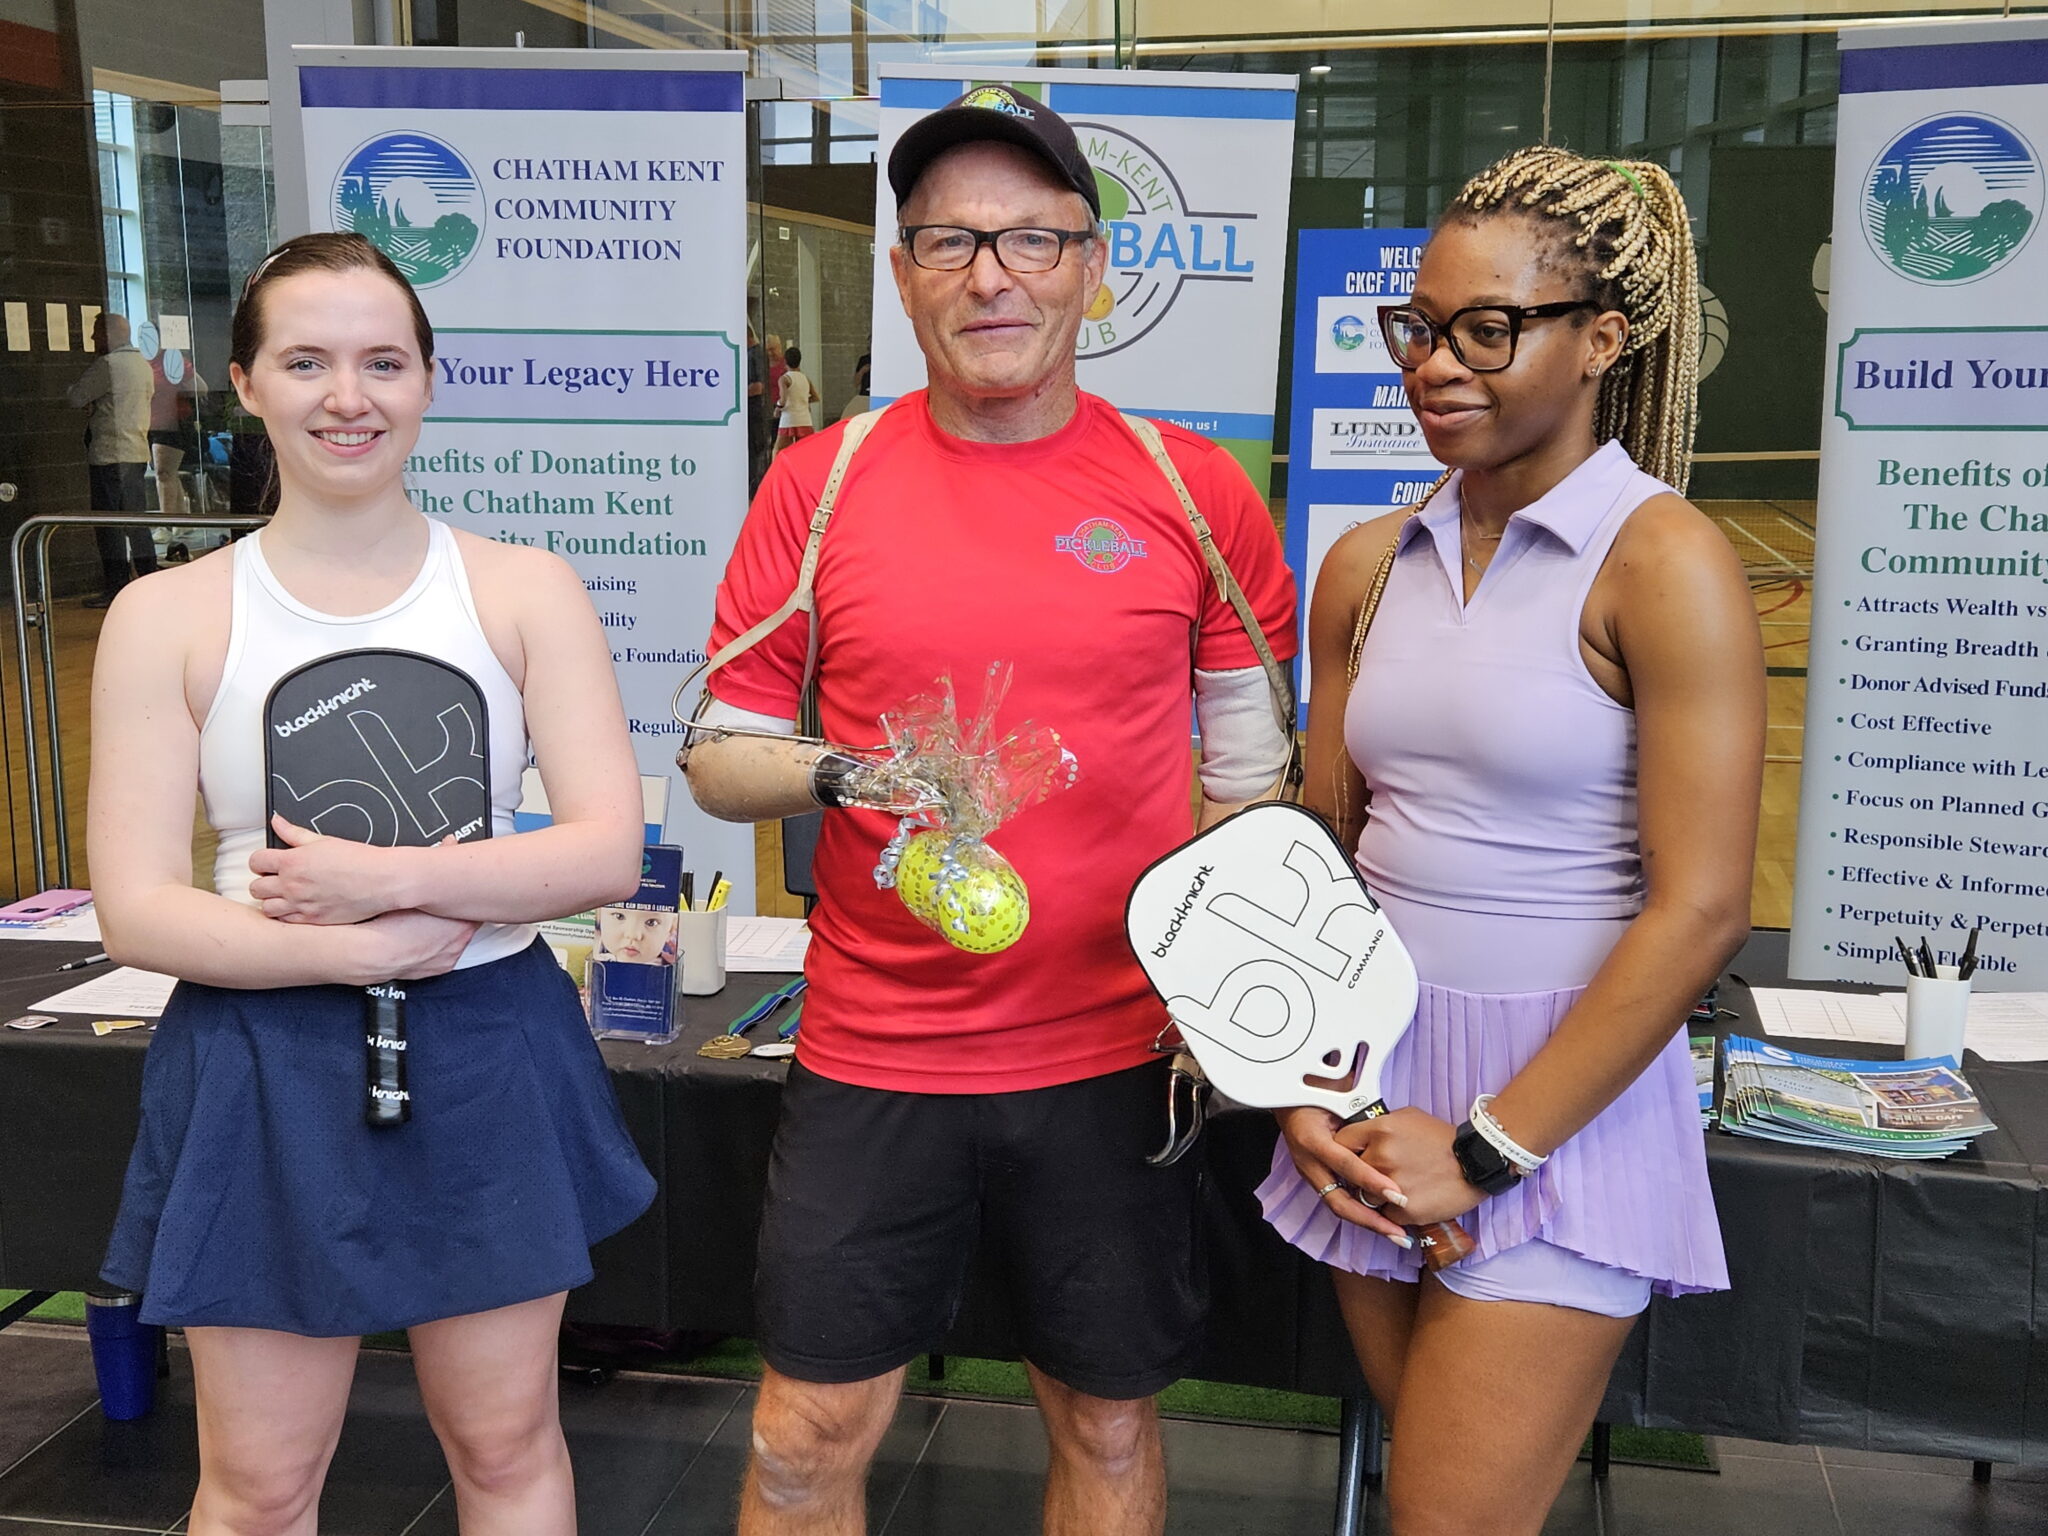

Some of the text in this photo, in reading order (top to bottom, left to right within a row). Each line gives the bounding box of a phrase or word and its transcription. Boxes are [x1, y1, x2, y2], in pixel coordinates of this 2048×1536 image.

[493, 158, 726, 183] CHATHAM KENT
[494, 198, 677, 221] COMMUNITY
[496, 237, 682, 261] FOUNDATION
[1099, 220, 1254, 273] BALL
[1345, 271, 1385, 294] CKCF
[438, 357, 721, 394] Your Legacy Here
[1854, 359, 1953, 390] Build
[1197, 421, 1210, 431] us
[1330, 421, 1424, 437] LUND
[1346, 434, 1420, 449] Insurance
[494, 449, 523, 475] of
[530, 449, 662, 482] Donating
[670, 452, 697, 477] to
[1877, 459, 2011, 488] Benefits
[406, 488, 674, 517] The Chatham Kent
[1903, 503, 1968, 531] The
[544, 529, 708, 557] Foundation
[1055, 538, 1147, 557] PICKLEBALL
[1856, 596, 2048, 618] Attracts Wealth vs
[1855, 634, 2039, 659] Granting Breadth
[1850, 673, 1911, 692] Donor
[1913, 676, 1989, 696] Advised
[274, 677, 378, 738] blackknight
[628, 718, 688, 738] Regula
[1850, 712, 1992, 736] Cost Effective
[1848, 751, 1966, 774] Compliance
[1972, 759, 2016, 777] with
[1846, 789, 1904, 809] Focus
[1910, 797, 1934, 811] on
[1941, 795, 2025, 817] Planned
[1844, 827, 1964, 852] Responsible
[1841, 865, 2048, 897] Effective & Informe
[1150, 864, 1216, 958] blackknight
[1839, 903, 1943, 931] Perpetuity
[1950, 913, 1969, 930] &
[1347, 928, 1385, 989] COMMAND
[1836, 940, 1903, 964] Simple
[1938, 949, 2018, 973] Fleible
